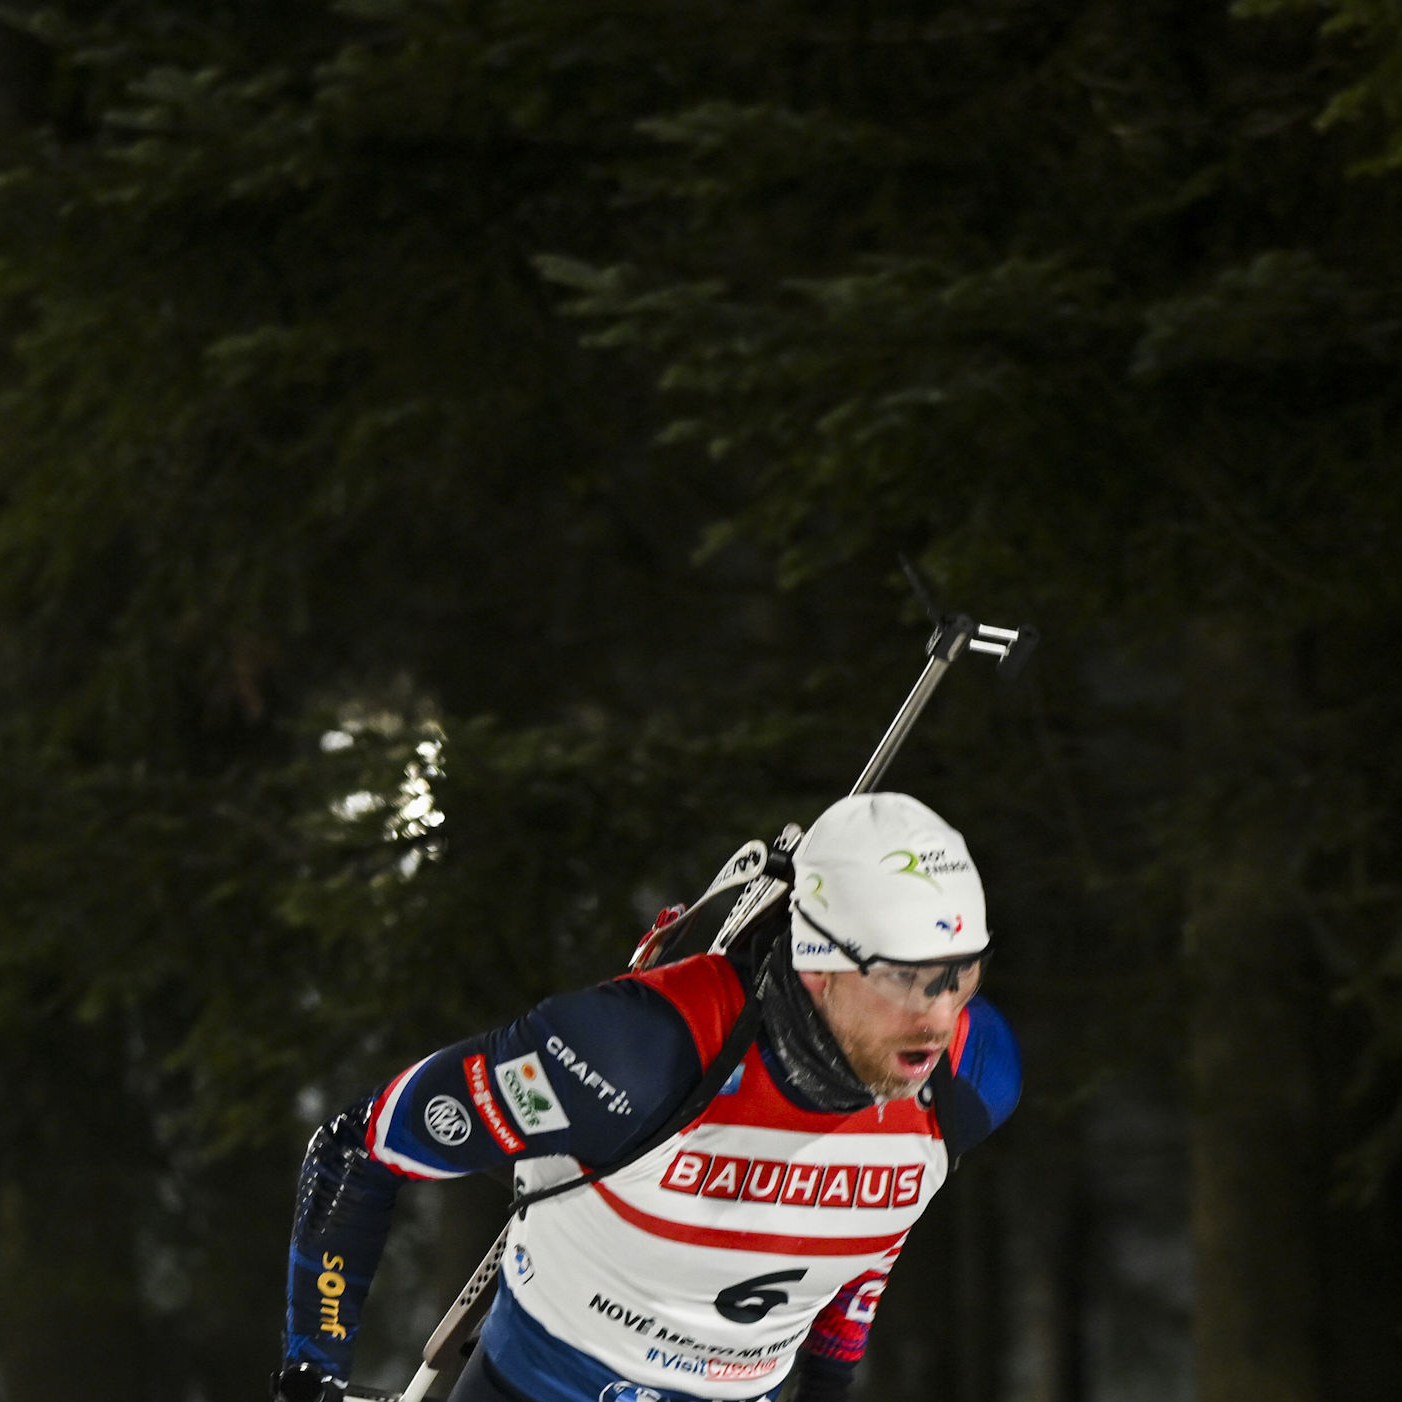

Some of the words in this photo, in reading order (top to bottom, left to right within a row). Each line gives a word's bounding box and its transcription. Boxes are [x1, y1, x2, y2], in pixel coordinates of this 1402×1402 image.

[546, 1036, 616, 1100] CRAFT
[668, 1154, 921, 1204] BAUHAUS
[589, 1294, 655, 1335] NOVÉ
[714, 1268, 808, 1324] 6
